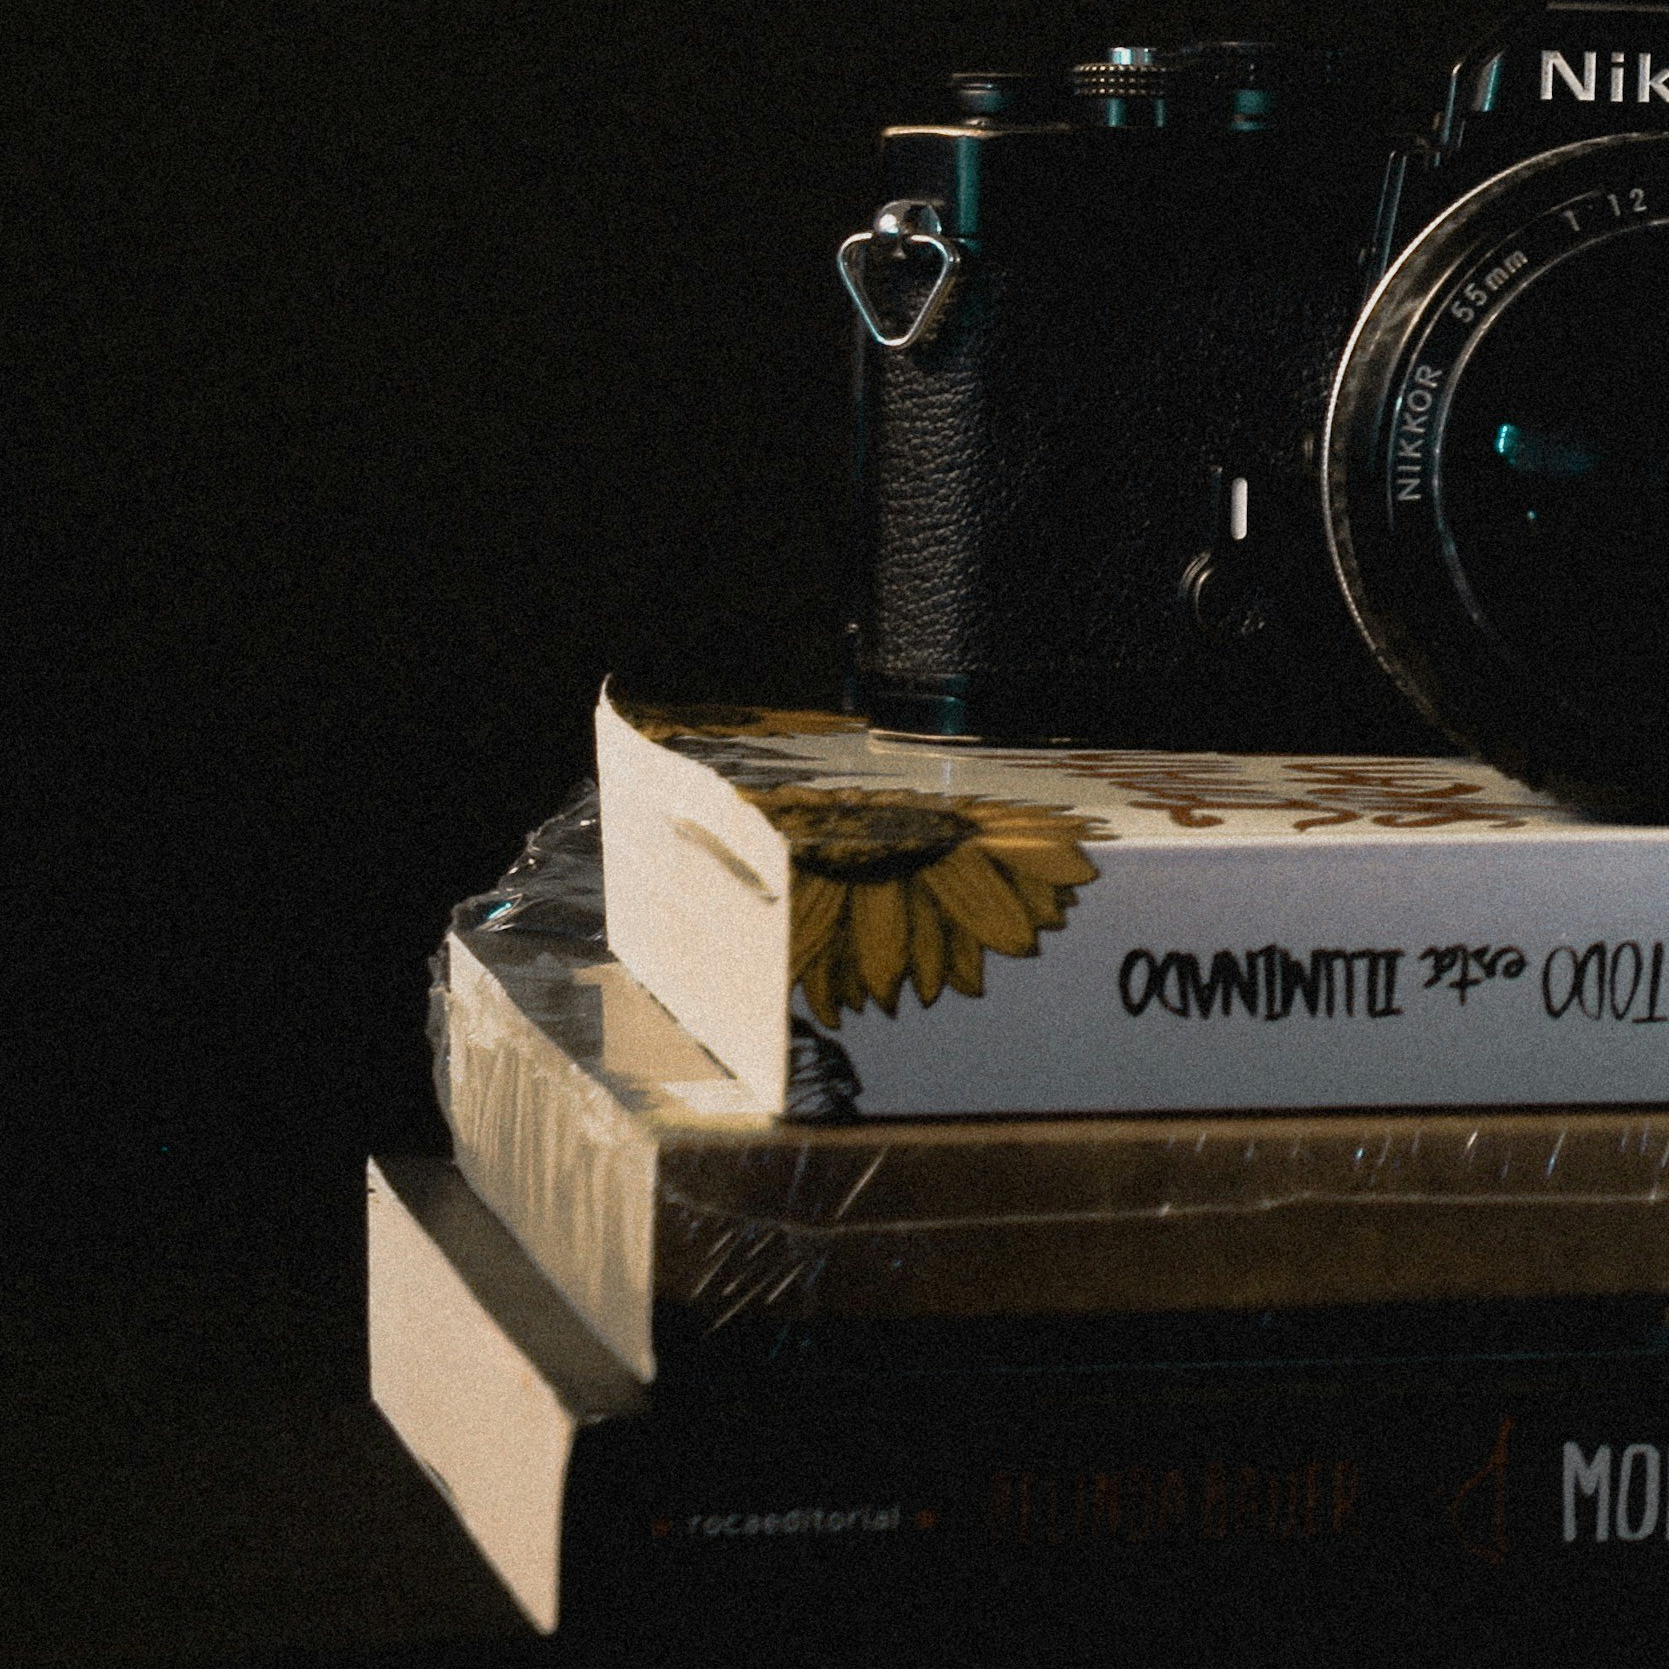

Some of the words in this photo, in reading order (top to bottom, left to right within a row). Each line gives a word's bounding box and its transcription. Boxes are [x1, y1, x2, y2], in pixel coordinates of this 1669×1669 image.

[1397, 363, 1444, 502] NIKKOR
[1450, 249, 1530, 325] 55mm
[1116, 942, 1406, 1023] ILUMINADO
[1540, 940, 1669, 1026] TODO
[685, 1501, 903, 1537] rocaeditorial
[1200, 1459, 1362, 1545] BAUER
